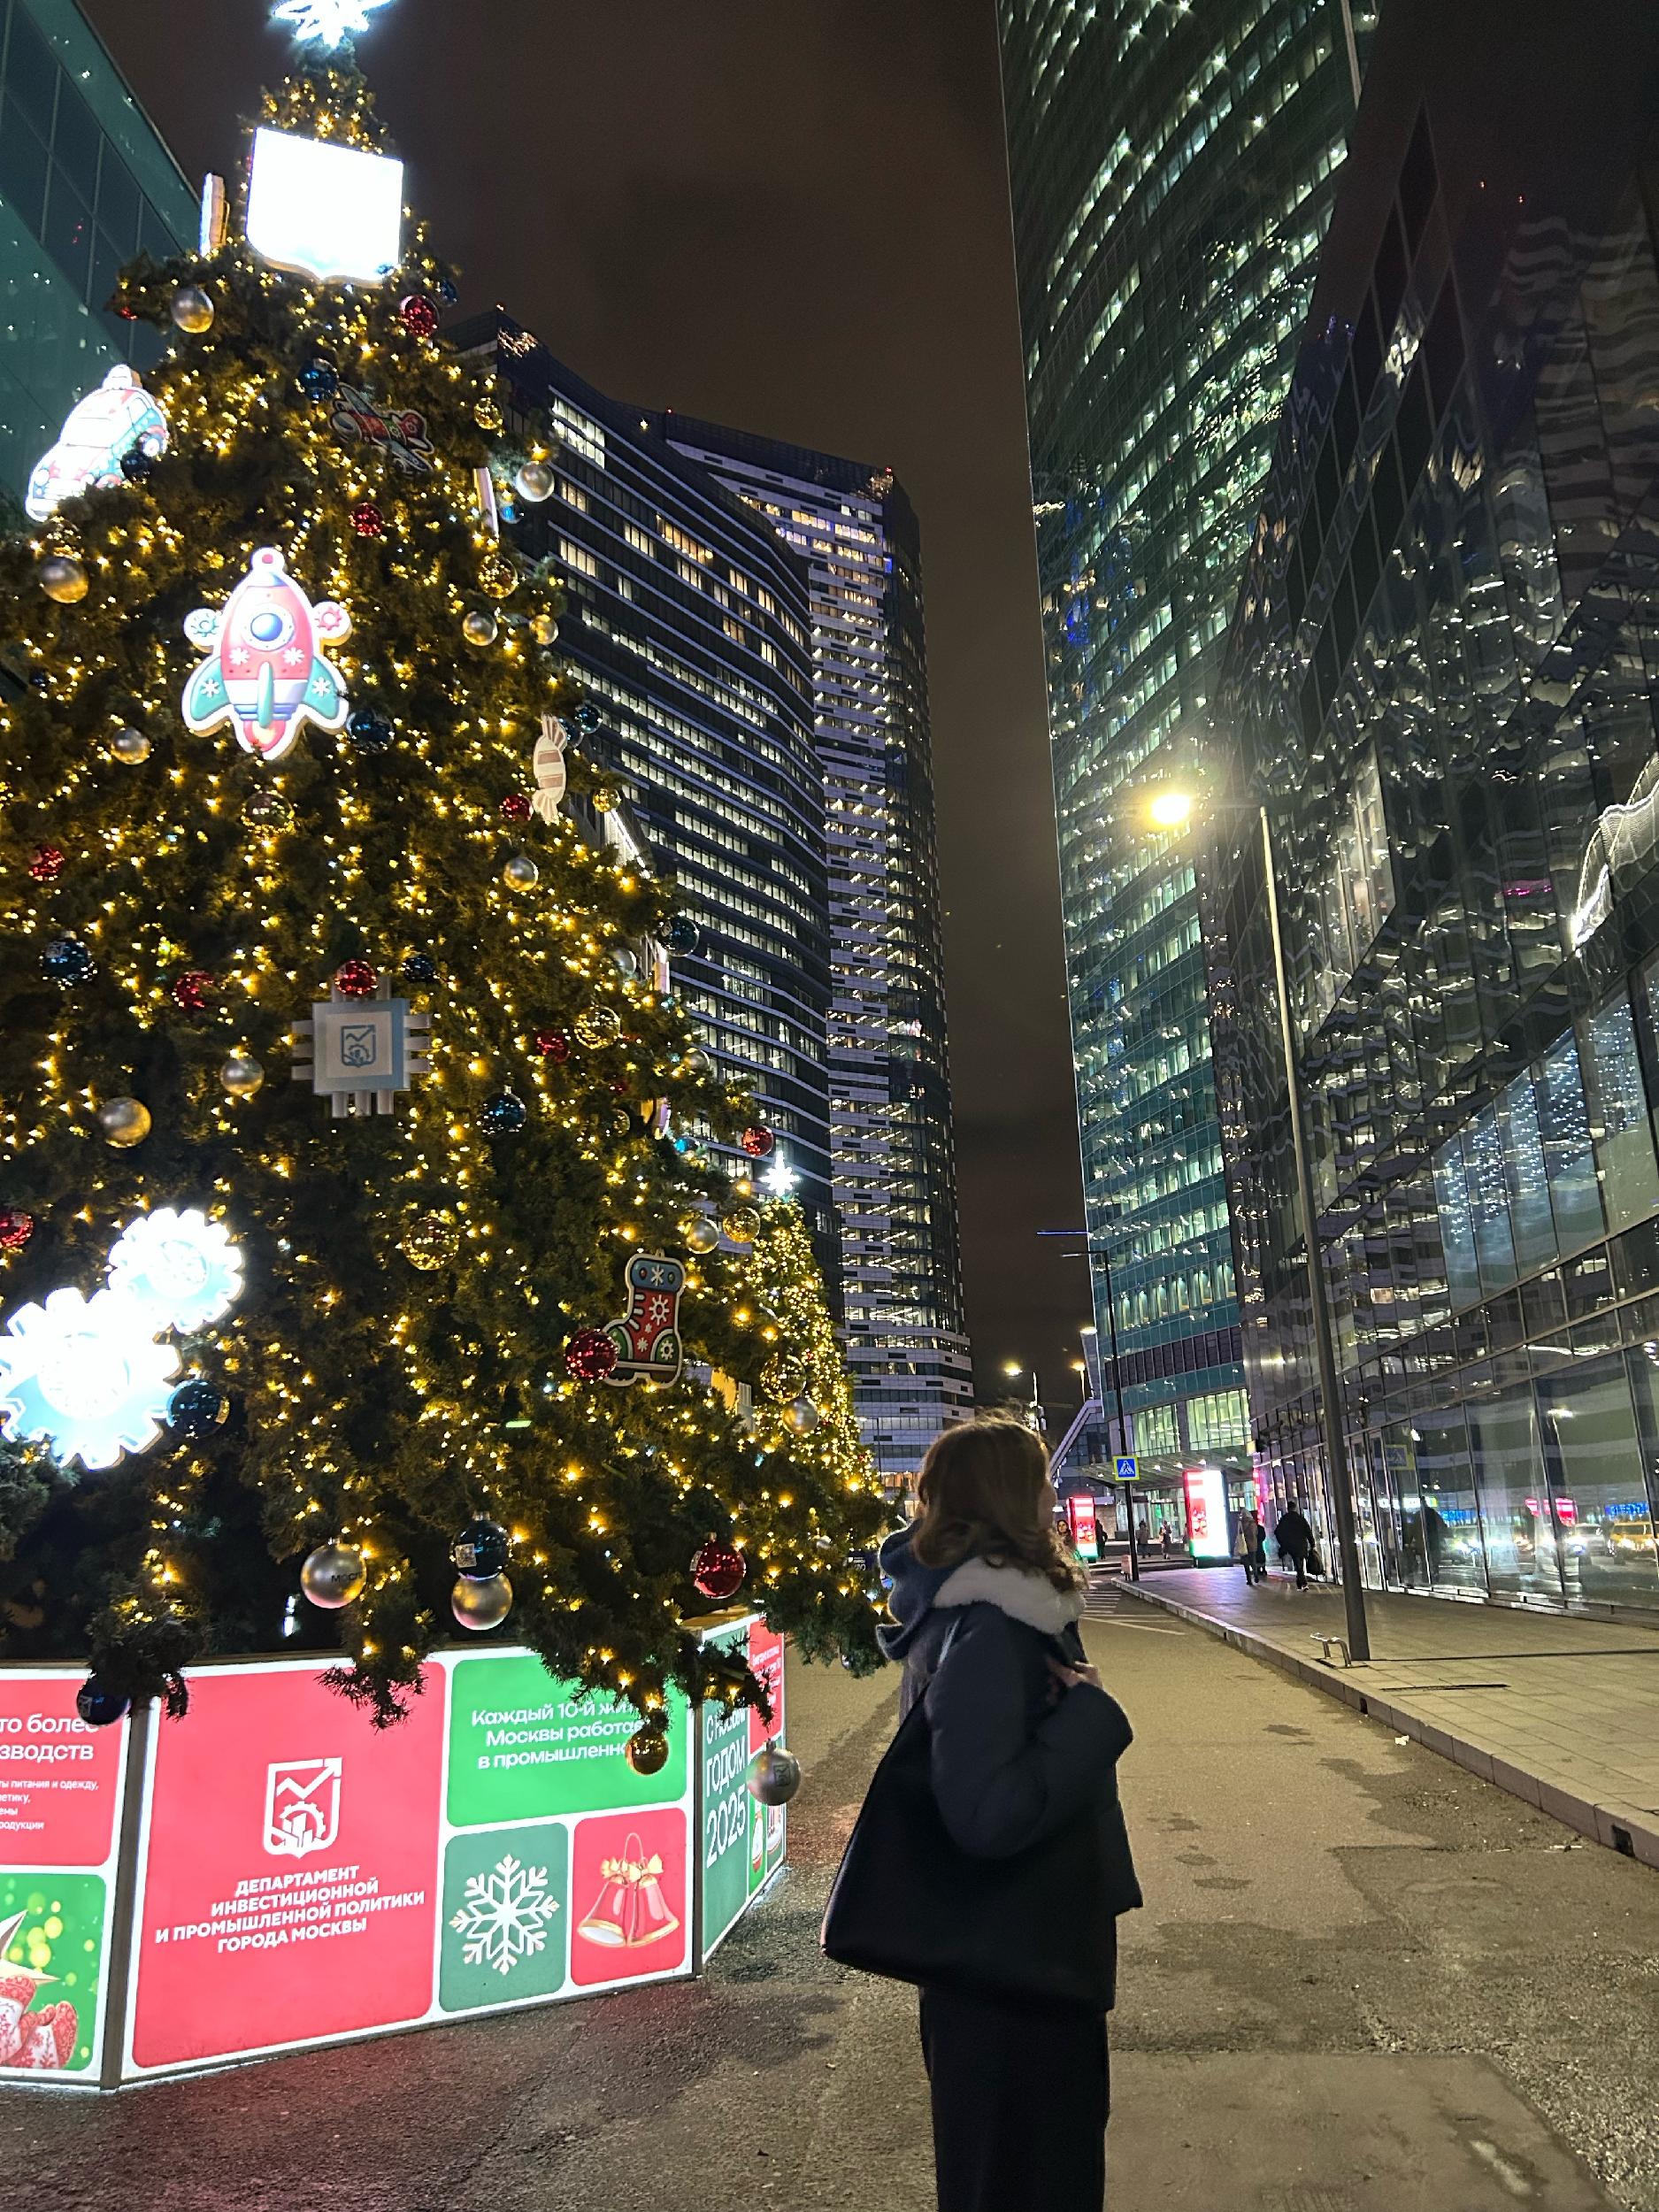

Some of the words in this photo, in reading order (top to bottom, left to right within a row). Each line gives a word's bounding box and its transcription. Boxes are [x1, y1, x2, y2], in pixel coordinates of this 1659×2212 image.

[472, 1703, 554, 1727] Каждый
[557, 1701, 595, 1719] 10-й
[486, 1727, 564, 1747] Москвы
[567, 1719, 650, 1741] работае
[478, 1755, 490, 1770] в
[706, 1734, 746, 1798] ГОДОМ
[59, 1780, 99, 1792] одежду,
[706, 1783, 746, 1870] 2025
[211, 1877, 379, 1916] ИНВЕСТИЦИОННОЙ
[234, 1865, 360, 1898] ДЕПАРТАМЕНТ
[155, 1929, 169, 1943] И
[173, 1902, 331, 1941] ПРОМЫШЛЕННОЙ
[334, 1891, 426, 1916] ПОЛИТИКИ
[218, 1932, 289, 1954] ГОРОДА
[291, 1917, 367, 1942] МОСКВЫ
